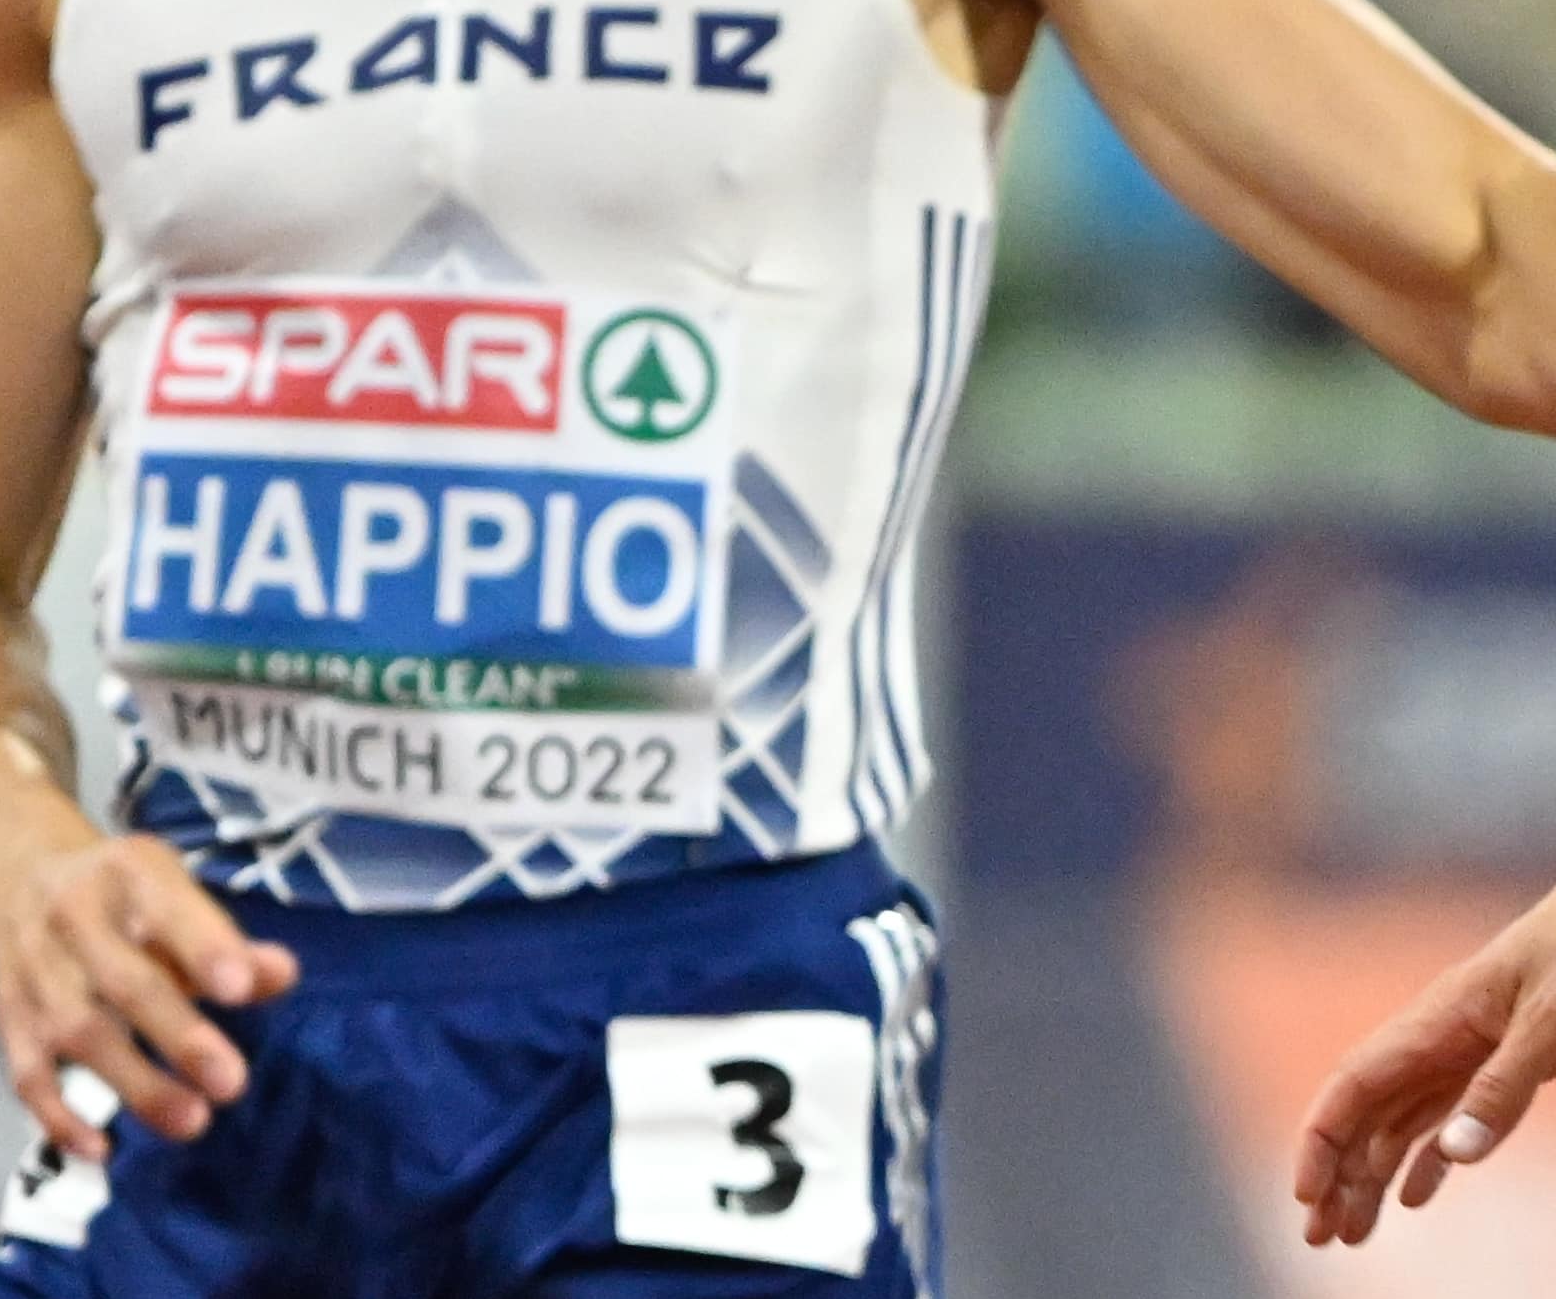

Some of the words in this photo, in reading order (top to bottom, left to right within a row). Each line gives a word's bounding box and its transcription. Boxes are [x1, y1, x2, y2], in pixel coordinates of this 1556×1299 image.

[138, 7, 782, 151] FRANCE
[158, 308, 555, 415] SPAR
[132, 475, 698, 637] HAPPIO
[171, 690, 442, 795] MUNICH
[478, 732, 678, 803] 2022
[706, 1057, 805, 1217] 3
